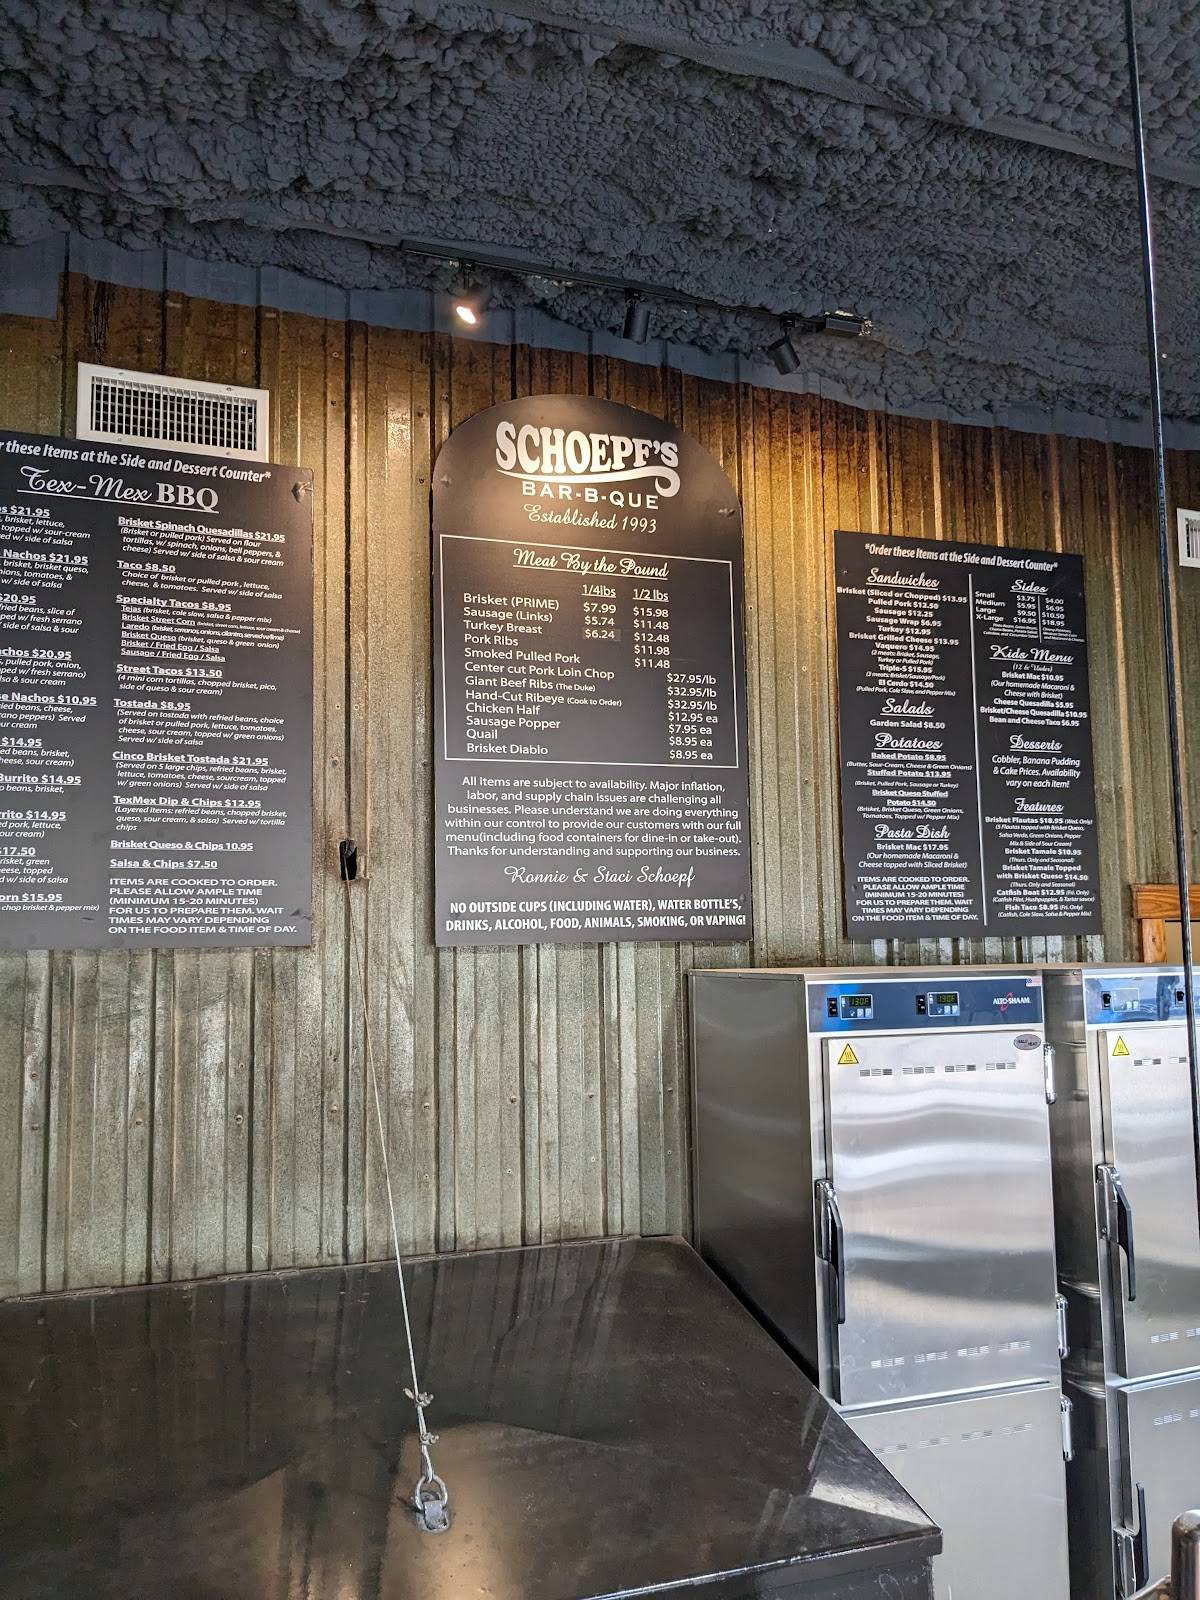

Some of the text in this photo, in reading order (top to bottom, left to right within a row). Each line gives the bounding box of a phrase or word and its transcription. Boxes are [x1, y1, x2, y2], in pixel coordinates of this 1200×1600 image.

[496, 421, 678, 473] SCHOEPF’S
[6, 440, 41, 455] these
[42, 444, 79, 460] Items
[80, 450, 95, 462] at
[96, 450, 118, 464] the
[119, 453, 146, 468] Side
[147, 458, 172, 471] and
[173, 459, 218, 476] Dessert
[20, 466, 219, 511] Tex-Mex BBQ
[522, 481, 658, 509] BAR-B-QUE
[10, 506, 49, 517] $21.95
[524, 503, 656, 533] Established 1993
[118, 516, 285, 541] Brisket Spinach Quesadillas $21.95
[3, 550, 88, 564] Nachos $21.95
[514, 549, 669, 577] Meat By the Pound
[892, 545, 915, 558] these
[916, 548, 938, 560] Items
[939, 551, 948, 561] at
[949, 551, 962, 562] the
[962, 552, 980, 564] Side
[980, 555, 996, 565] and
[996, 556, 1024, 568] Dessert
[117, 560, 176, 573] Taco $8.50
[866, 568, 939, 588] Sandwiches
[1011, 579, 1048, 593] Sides
[116, 594, 231, 611] Specialty Tacos $8.95
[633, 589, 669, 601] 1/2 lbs
[463, 592, 668, 617] Brisket (PRIME) $7.99 $15.98
[463, 606, 669, 630] Sausage (Links) $5.74 $11.48
[463, 619, 669, 642] Turkey Breast $6.24 $12.48
[464, 633, 669, 655] Pork Ribs $11.98
[464, 647, 670, 668] Smoked Pulled Pork $11.48
[1030, 648, 1074, 663] Menu
[116, 664, 222, 676] Street Tacos $13.50
[464, 661, 716, 684] Center cut Pork Loin Chop $27.95/lb
[464, 675, 716, 697] Giant Beef Ribs (The Duke) $32.95/lb
[12, 692, 96, 705] Nachos $10.95
[113, 698, 190, 710] Tostada $8.95
[465, 689, 522, 701] Hand-Cut
[525, 692, 564, 705] Ribeye
[598, 698, 621, 706] Order)
[667, 698, 717, 710] $32.95/lb
[880, 698, 934, 716] Salads
[465, 702, 718, 723] Chicken Half $12.95 ea
[466, 715, 712, 734] Sausage Popper $7.95 ea
[870, 719, 945, 729] Garden Salad $8.50
[466, 728, 497, 739] Quail
[669, 735, 697, 746] $8.95
[874, 732, 943, 750] Potatoes
[1010, 734, 1062, 751] Desserts
[467, 742, 712, 760] Brisket Diablo $8.95 ea
[991, 754, 1080, 767] Cobbler, Banana Pudding
[462, 776, 725, 792] All items are subject to availability. Major inflation,
[1014, 798, 1064, 813] Features
[875, 824, 950, 840] Pasta Dish
[110, 859, 217, 869] Salsa & Chips $7.50
[504, 866, 695, 887] Ronnie & Staci Schoepf
[450, 902, 466, 913] NO
[468, 901, 516, 912] OUTSIDE
[519, 901, 547, 912] CUPS
[549, 900, 611, 912] (INCLUDING
[613, 898, 655, 911] WATER),
[657, 899, 692, 910] WATER
[446, 914, 746, 931] DRINKS, ALCOHOL, FOOD, ANIMALS, SMOKING, OR VAPING!
